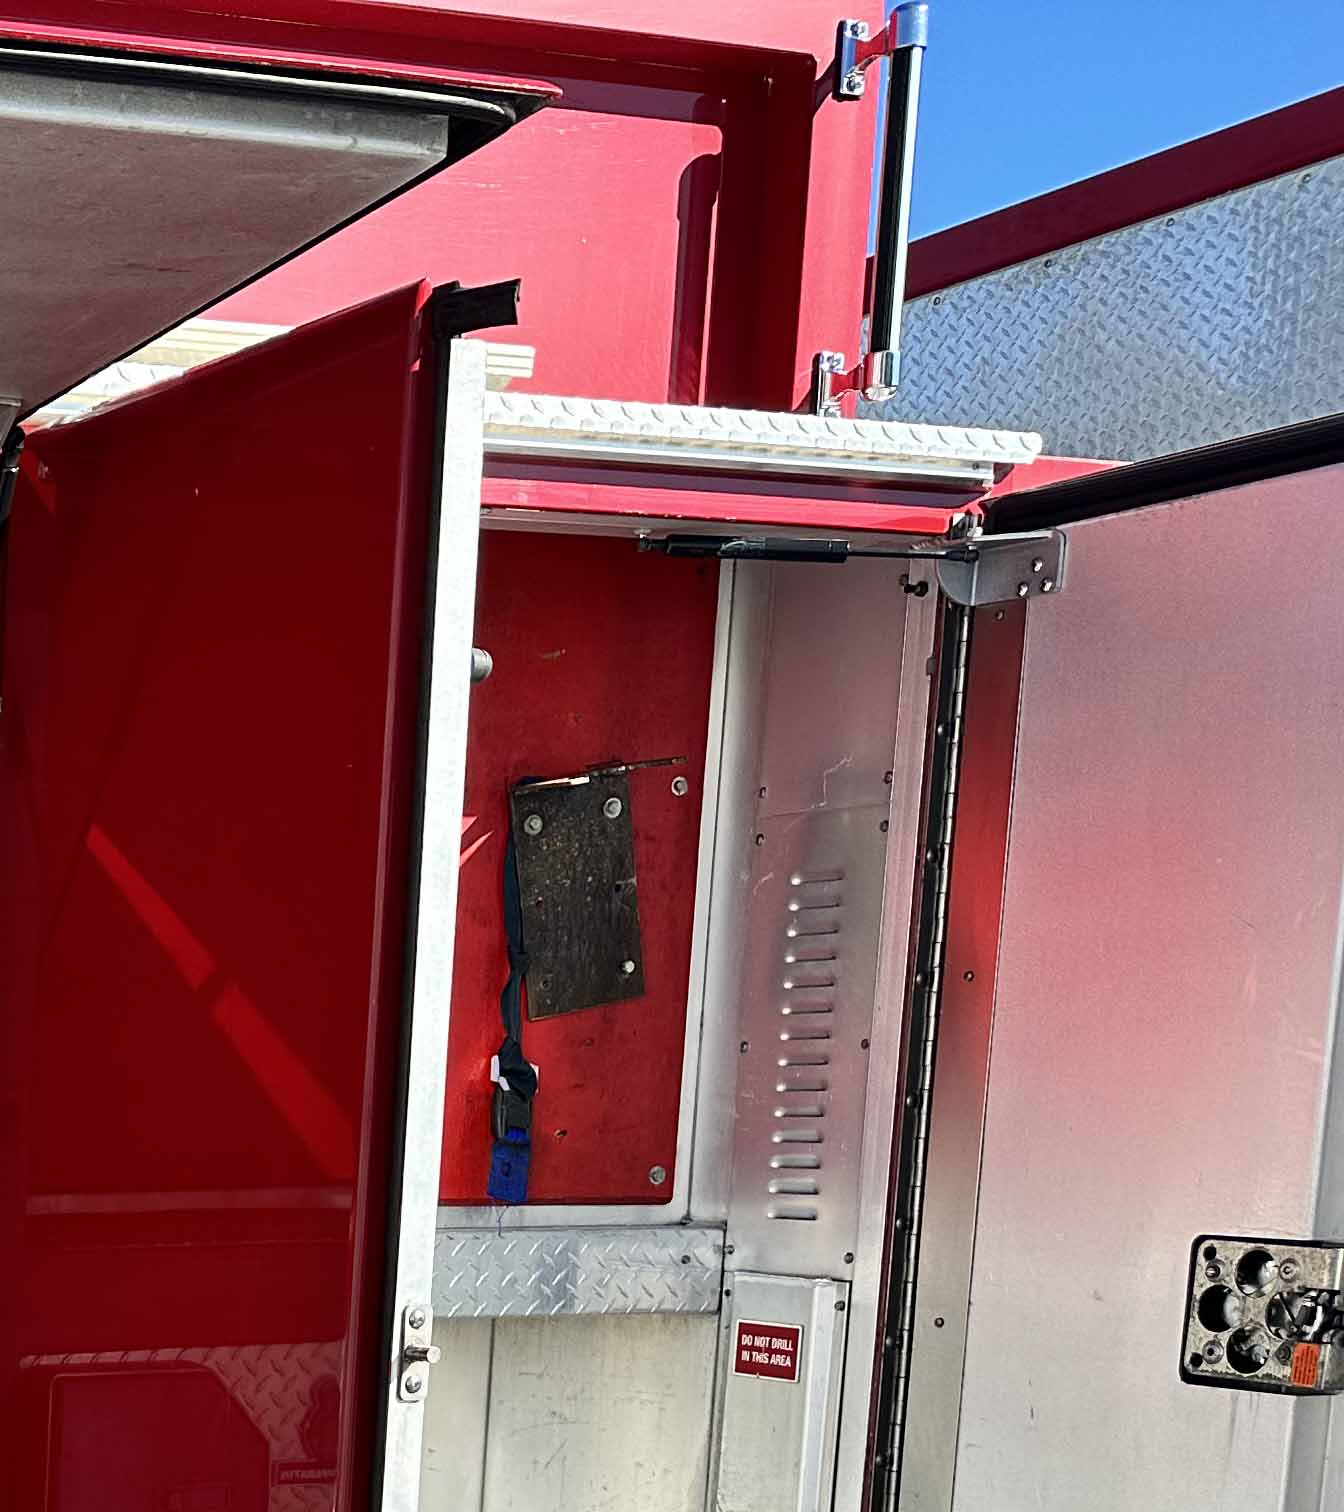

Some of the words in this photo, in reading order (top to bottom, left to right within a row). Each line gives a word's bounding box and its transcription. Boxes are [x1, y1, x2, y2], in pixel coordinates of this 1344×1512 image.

[741, 1334, 753, 1346] DO
[754, 1335, 771, 1348] NOT
[772, 1337, 794, 1351] DRILL
[741, 1350, 750, 1362] IN
[752, 1351, 769, 1364] THIS
[770, 1354, 792, 1367] AREA
